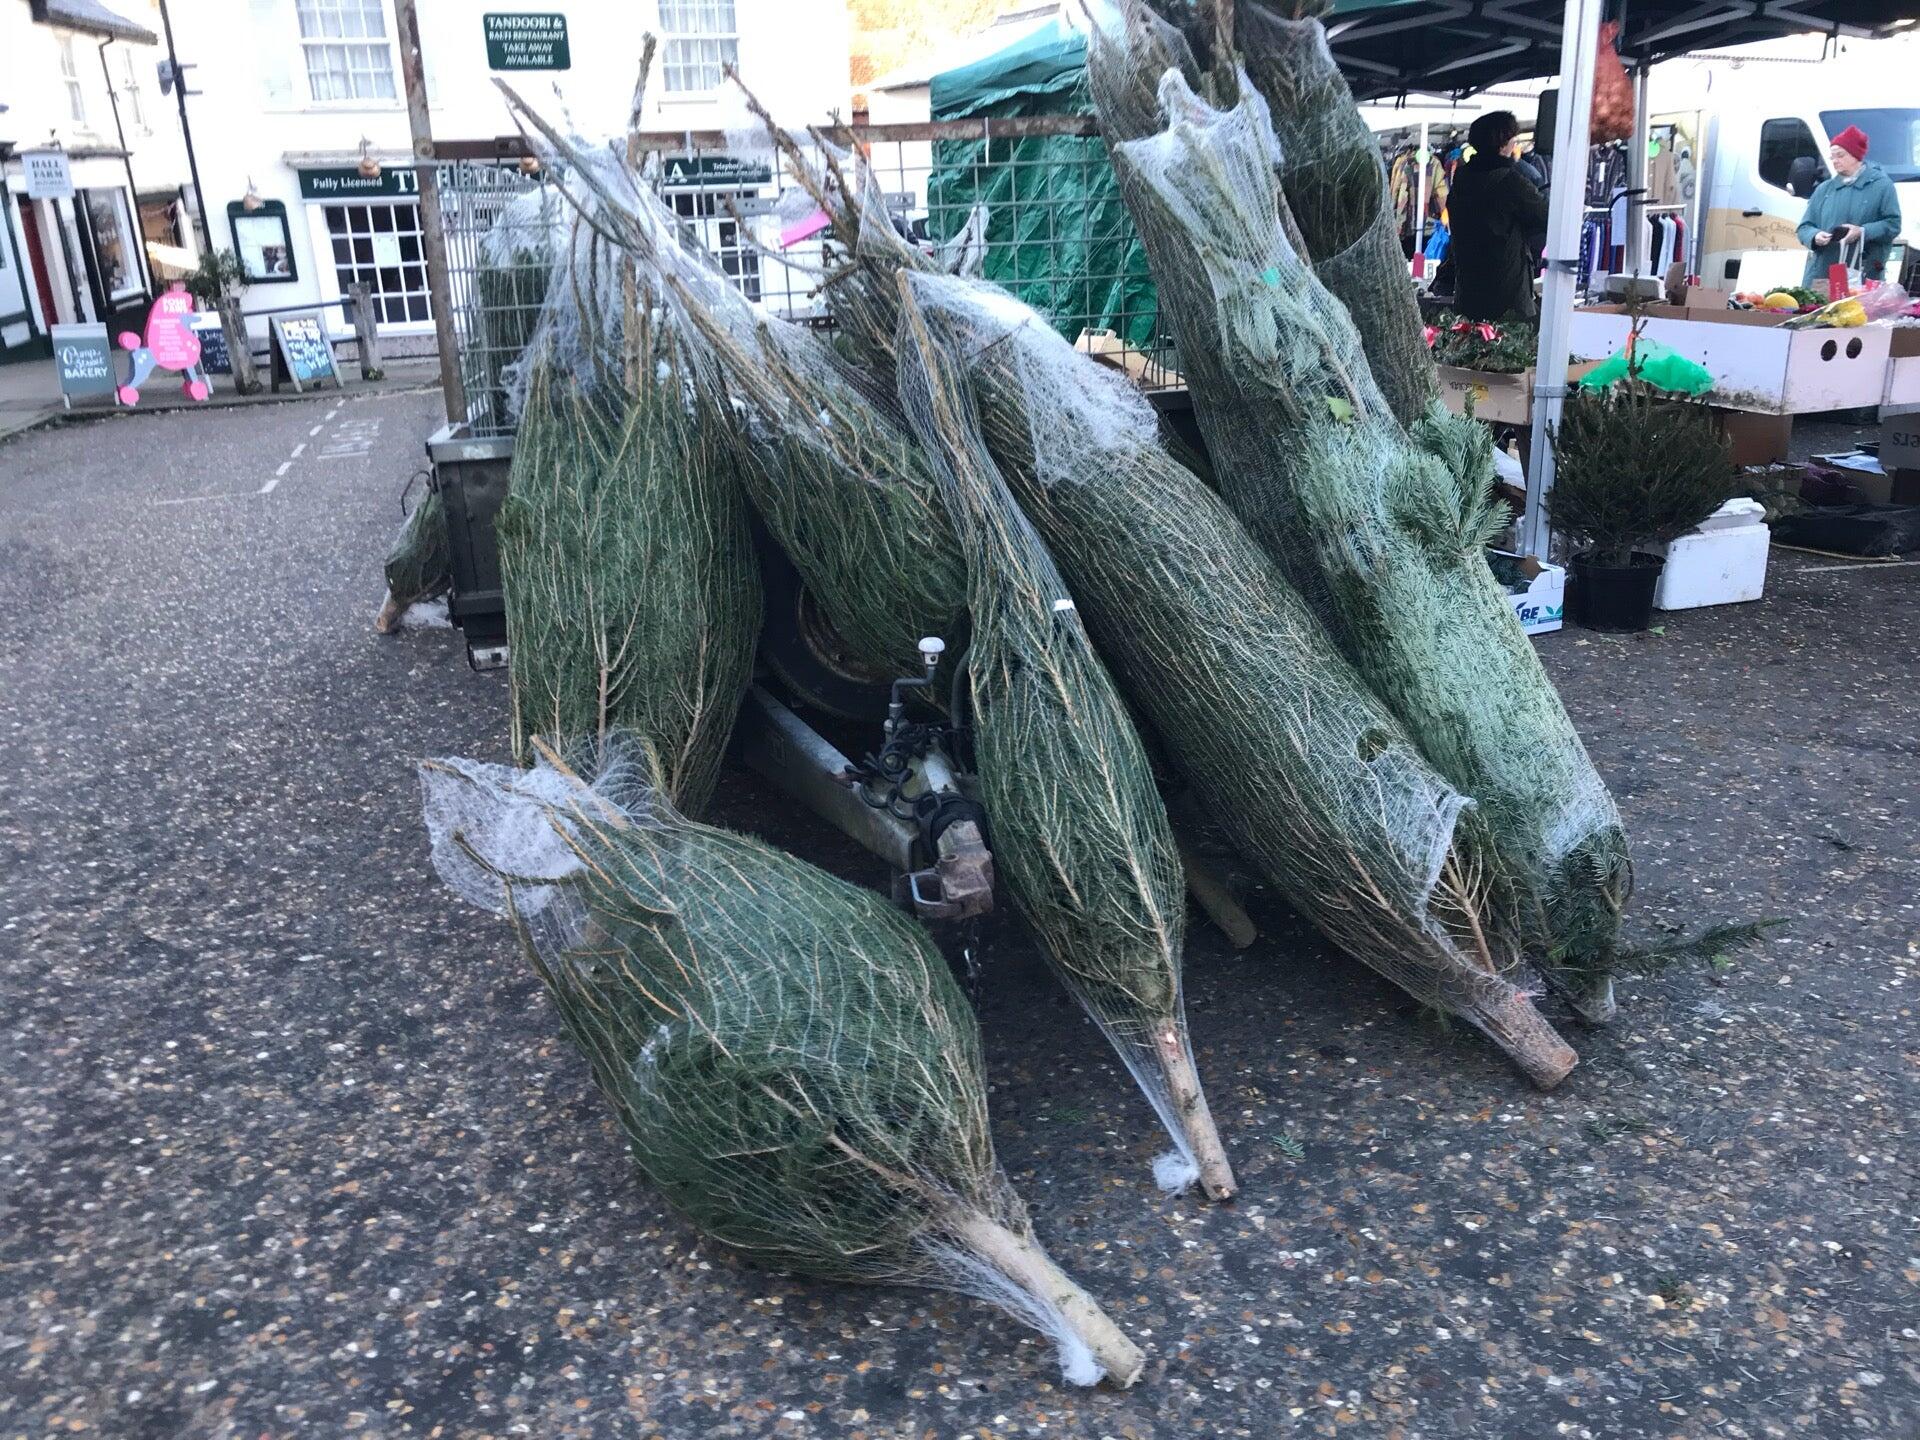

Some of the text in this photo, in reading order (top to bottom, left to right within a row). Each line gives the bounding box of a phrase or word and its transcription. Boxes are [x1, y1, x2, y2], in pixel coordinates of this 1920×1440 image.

[487, 16, 563, 30] TANDOORI &
[502, 42, 553, 54] TAKE AWAY
[505, 54, 554, 66] AVAILABLE
[313, 177, 338, 191] Fully
[341, 176, 383, 189] Licensed
[64, 366, 108, 379] BAKERY
